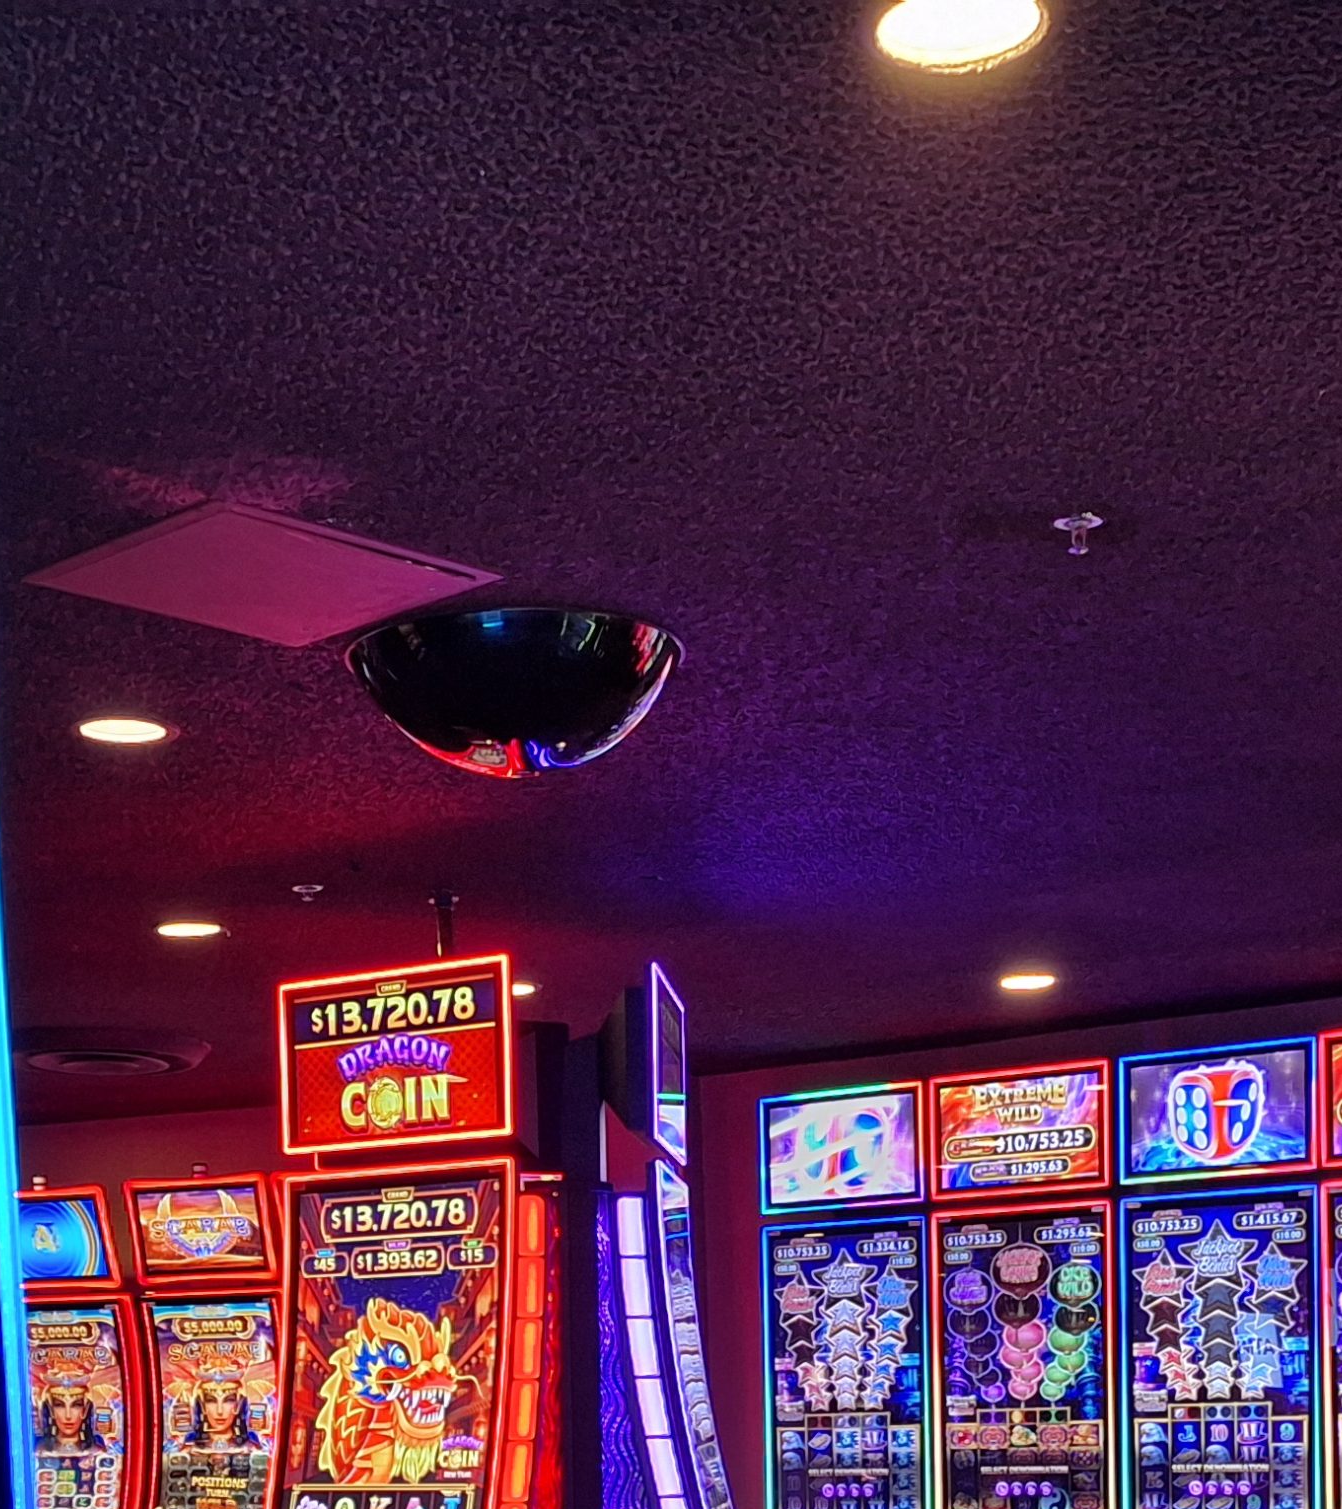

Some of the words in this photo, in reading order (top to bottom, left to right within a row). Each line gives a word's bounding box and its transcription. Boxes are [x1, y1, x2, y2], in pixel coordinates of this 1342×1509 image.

[338, 1034, 450, 1082] DRAGON
[341, 1073, 450, 1130] COIN
[972, 1079, 1068, 1113] EXTREME
[997, 1105, 1044, 1124] WILD
[996, 1130, 1085, 1153] $10,753.25
[150, 1217, 252, 1241] SCARAB
[314, 1257, 336, 1272] $45
[460, 1249, 485, 1264] $15
[168, 1341, 262, 1364] SCARAB
[1210, 1424, 1229, 1442] 10
[1279, 1422, 1296, 1441] 9
[438, 1450, 479, 1469] COIN
[1171, 1463, 1202, 1473] SELECT
[1203, 1463, 1270, 1473] DENOMINATION
[191, 1475, 248, 1489] POSITIONS
